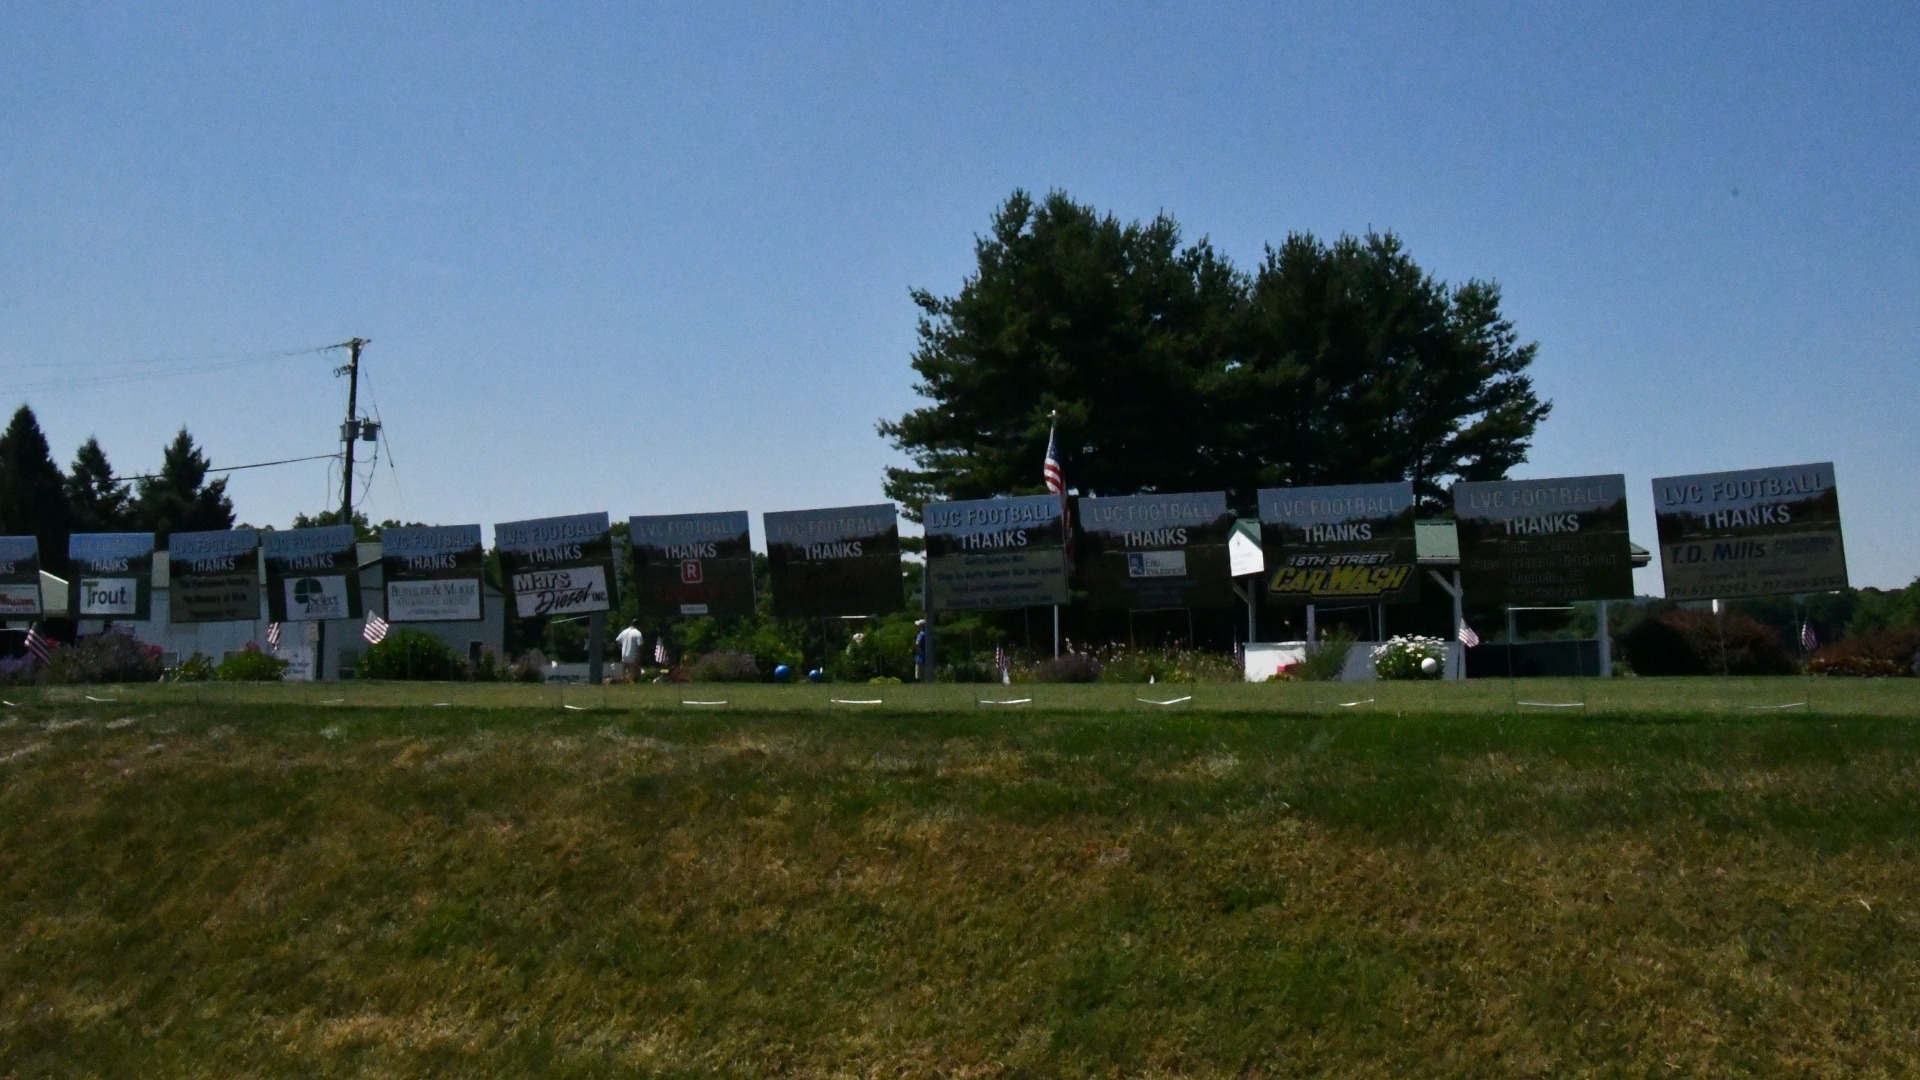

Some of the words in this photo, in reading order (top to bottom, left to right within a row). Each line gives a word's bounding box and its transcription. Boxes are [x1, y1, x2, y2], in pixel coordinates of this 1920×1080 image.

[1470, 490, 1504, 509] LVC
[1511, 485, 1609, 507] FOOTBALL
[1663, 485, 1703, 506] LVC
[1711, 473, 1826, 501] FOOTBALL
[931, 511, 961, 528] LVC
[968, 504, 1054, 526] FOOTBALL
[1093, 506, 1123, 522] LVC
[1128, 503, 1212, 521] FOOTBALL
[1273, 501, 1304, 518] LVC
[1311, 496, 1400, 516] FOOTBALL
[1703, 504, 1791, 529] THANKS
[501, 528, 528, 546] LVC
[534, 520, 603, 542] FOOTBALL
[667, 519, 735, 536] FOOTBALL
[1303, 523, 1373, 543] THANKS
[1503, 514, 1580, 536] THANKS
[413, 531, 475, 550] FOOTBALL
[961, 530, 1028, 549] THANKS
[1122, 528, 1188, 547] THANKS
[529, 544, 583, 564] THANKS
[664, 542, 718, 560] THANKS
[803, 541, 864, 560] THANKS
[1288, 556, 1327, 567] 16TH
[1328, 553, 1391, 566] STREET
[1670, 545, 1707, 565] T.D.
[1713, 541, 1766, 562] Mills
[91, 558, 129, 573] THANKS
[191, 557, 236, 572] THANKS
[289, 554, 335, 570] THANKS
[407, 554, 457, 570] THANKS
[686, 563, 698, 579] R
[513, 571, 572, 593] Mars
[1269, 566, 1328, 593] CAR
[1326, 565, 1413, 594] WASH
[82, 581, 127, 608] Trout
[534, 581, 593, 615] Diesel
